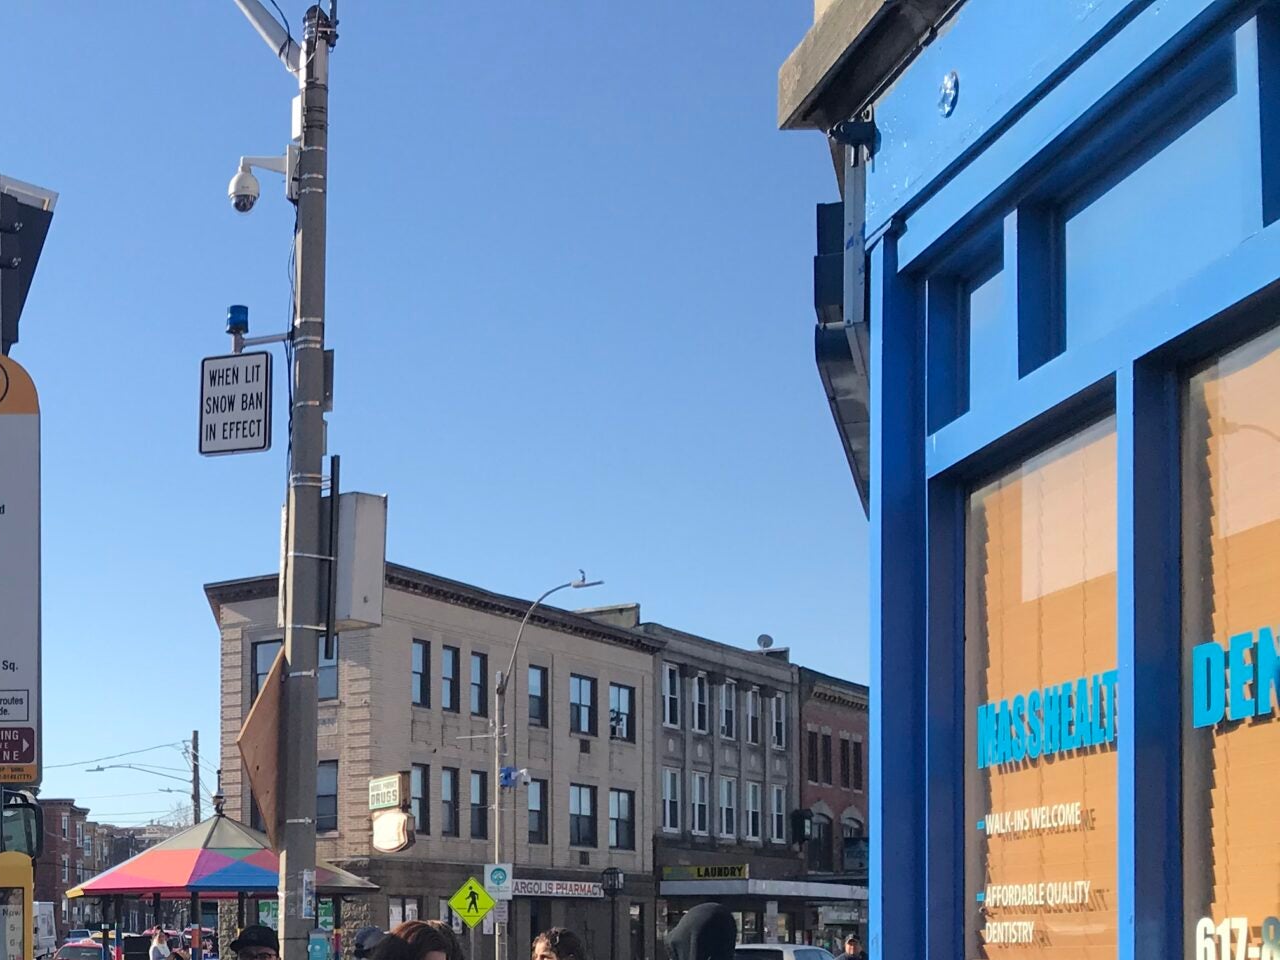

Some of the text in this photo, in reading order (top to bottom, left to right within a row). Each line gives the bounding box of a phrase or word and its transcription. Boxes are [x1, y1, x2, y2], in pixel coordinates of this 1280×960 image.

[209, 365, 261, 387] WHEN LIT
[205, 391, 263, 415] SNOW BAN
[205, 419, 262, 442] IN EFFECT
[2, 660, 19, 673] Sq.
[0, 696, 24, 706] routes
[370, 788, 398, 806] DRUGS
[985, 801, 1081, 835] WALK-INS WELCOME
[697, 866, 744, 878] LAUNDRY
[555, 882, 604, 897] PHARMACY
[984, 880, 1091, 907] AFFORDABLE QUALITY
[984, 920, 1035, 944] DENTISTRY
